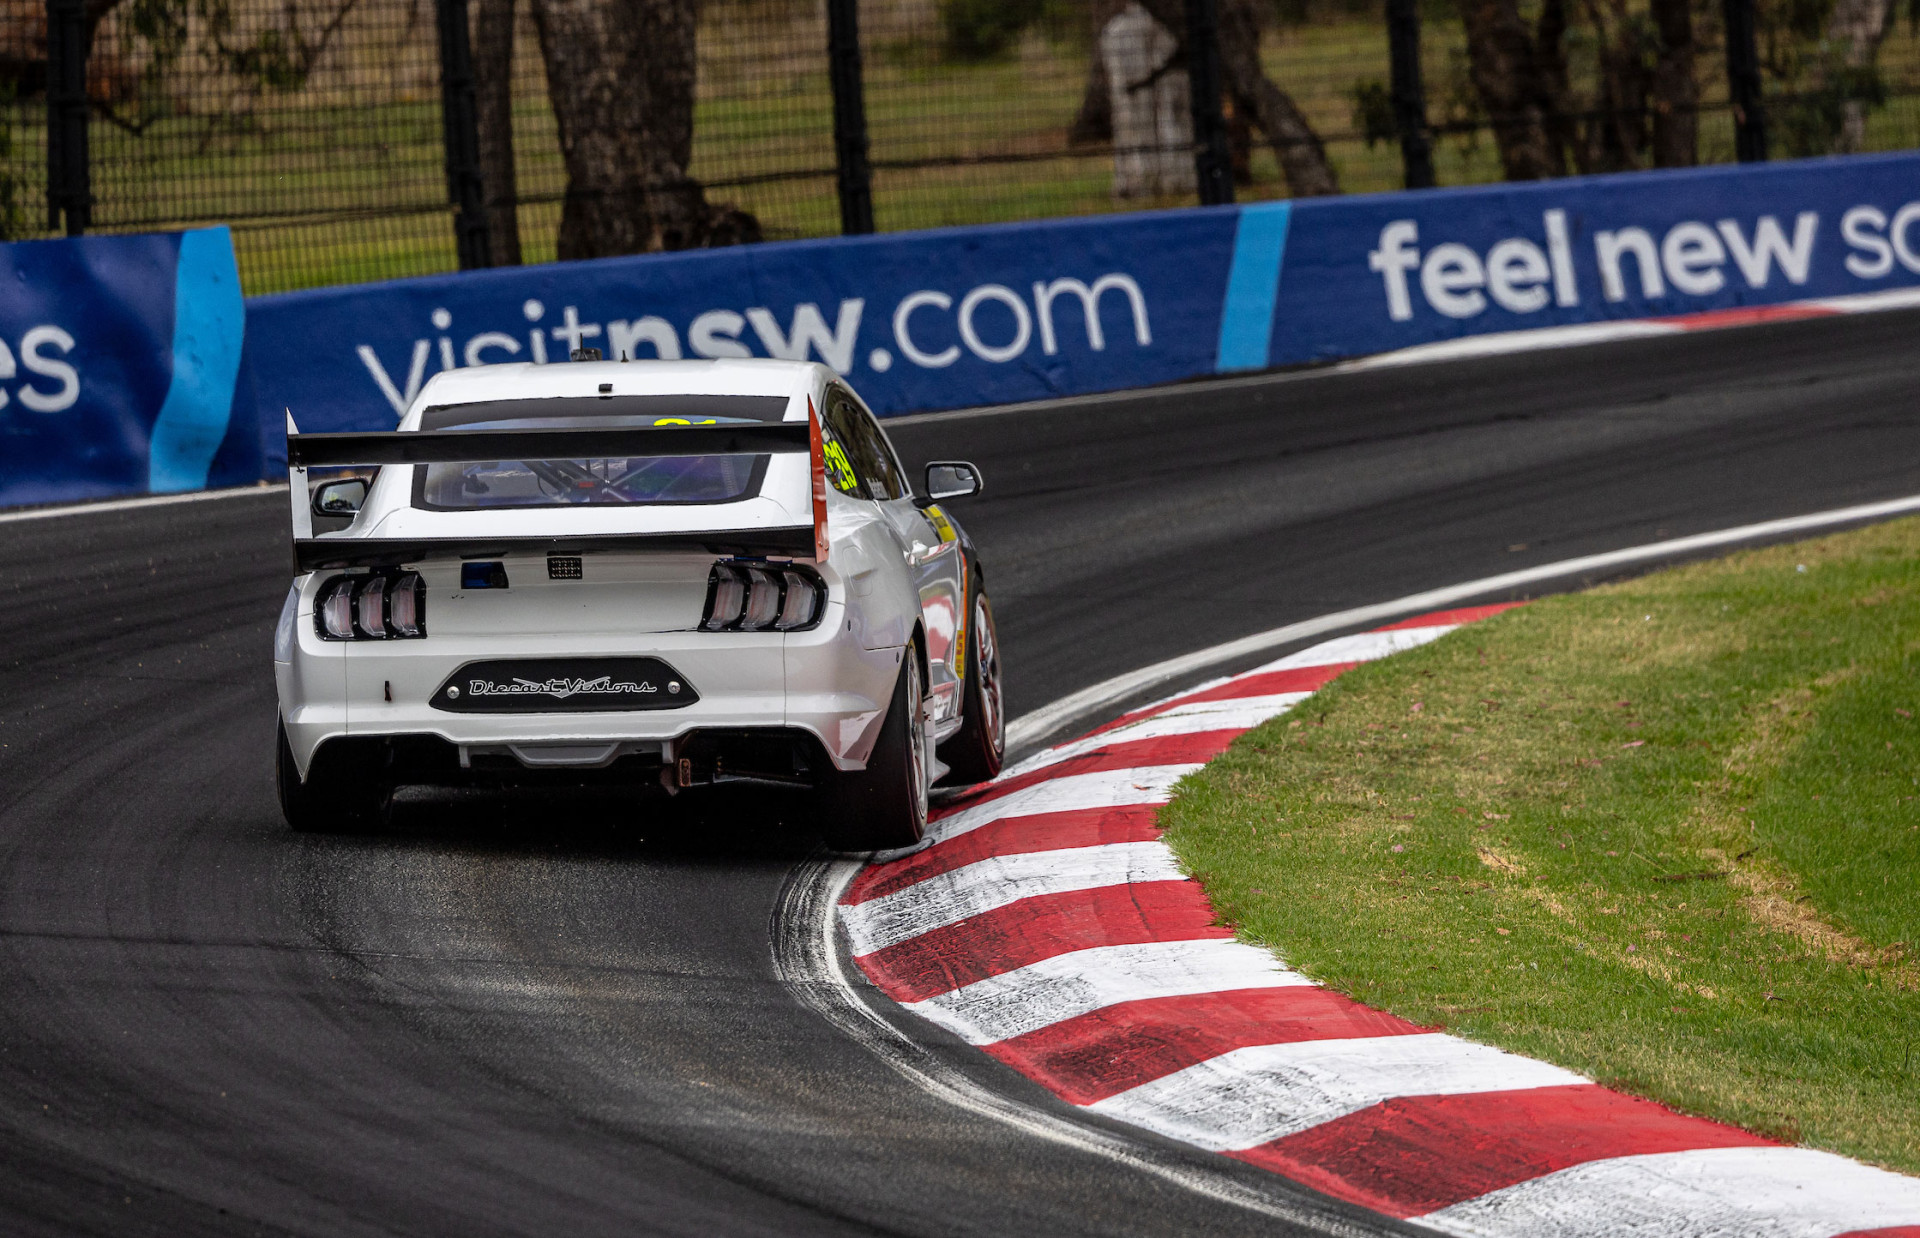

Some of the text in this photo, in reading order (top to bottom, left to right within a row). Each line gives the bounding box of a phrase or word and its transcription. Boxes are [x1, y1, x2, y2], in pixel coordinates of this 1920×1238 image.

[1368, 208, 1579, 321] feel
[1594, 211, 1819, 300] new
[0, 325, 80, 413] s
[469, 678, 658, 695] Diecast Visions
